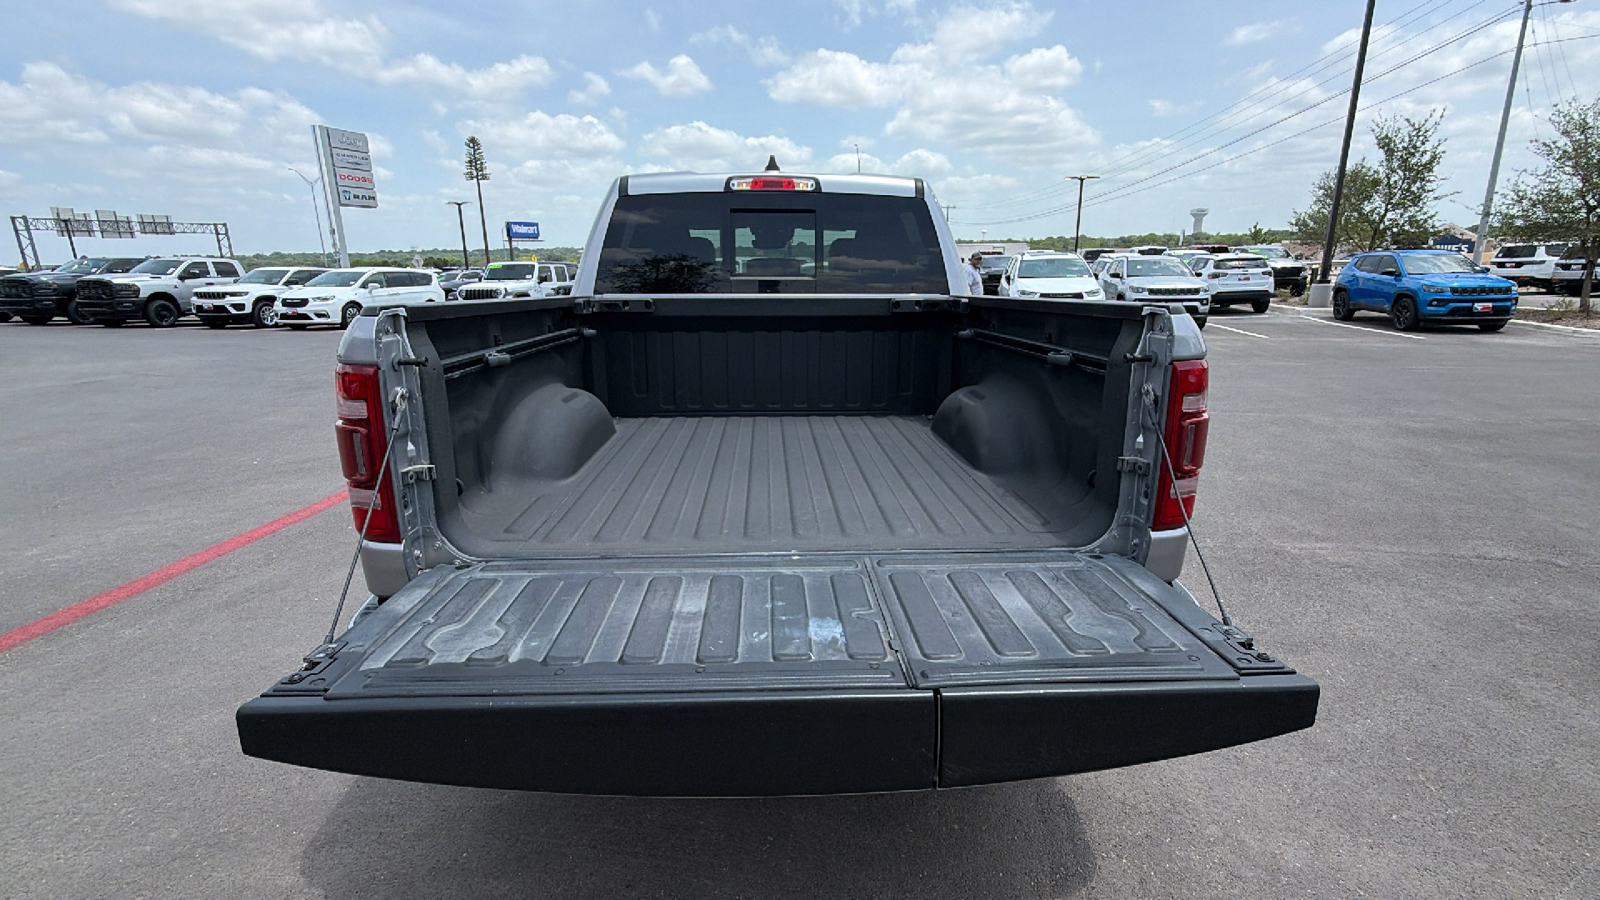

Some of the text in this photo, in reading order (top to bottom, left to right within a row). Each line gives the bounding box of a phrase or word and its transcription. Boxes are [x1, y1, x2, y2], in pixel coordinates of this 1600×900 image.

[339, 174, 373, 183] DODGE
[353, 193, 376, 201] RAM
[511, 223, 538, 234] Walmart
